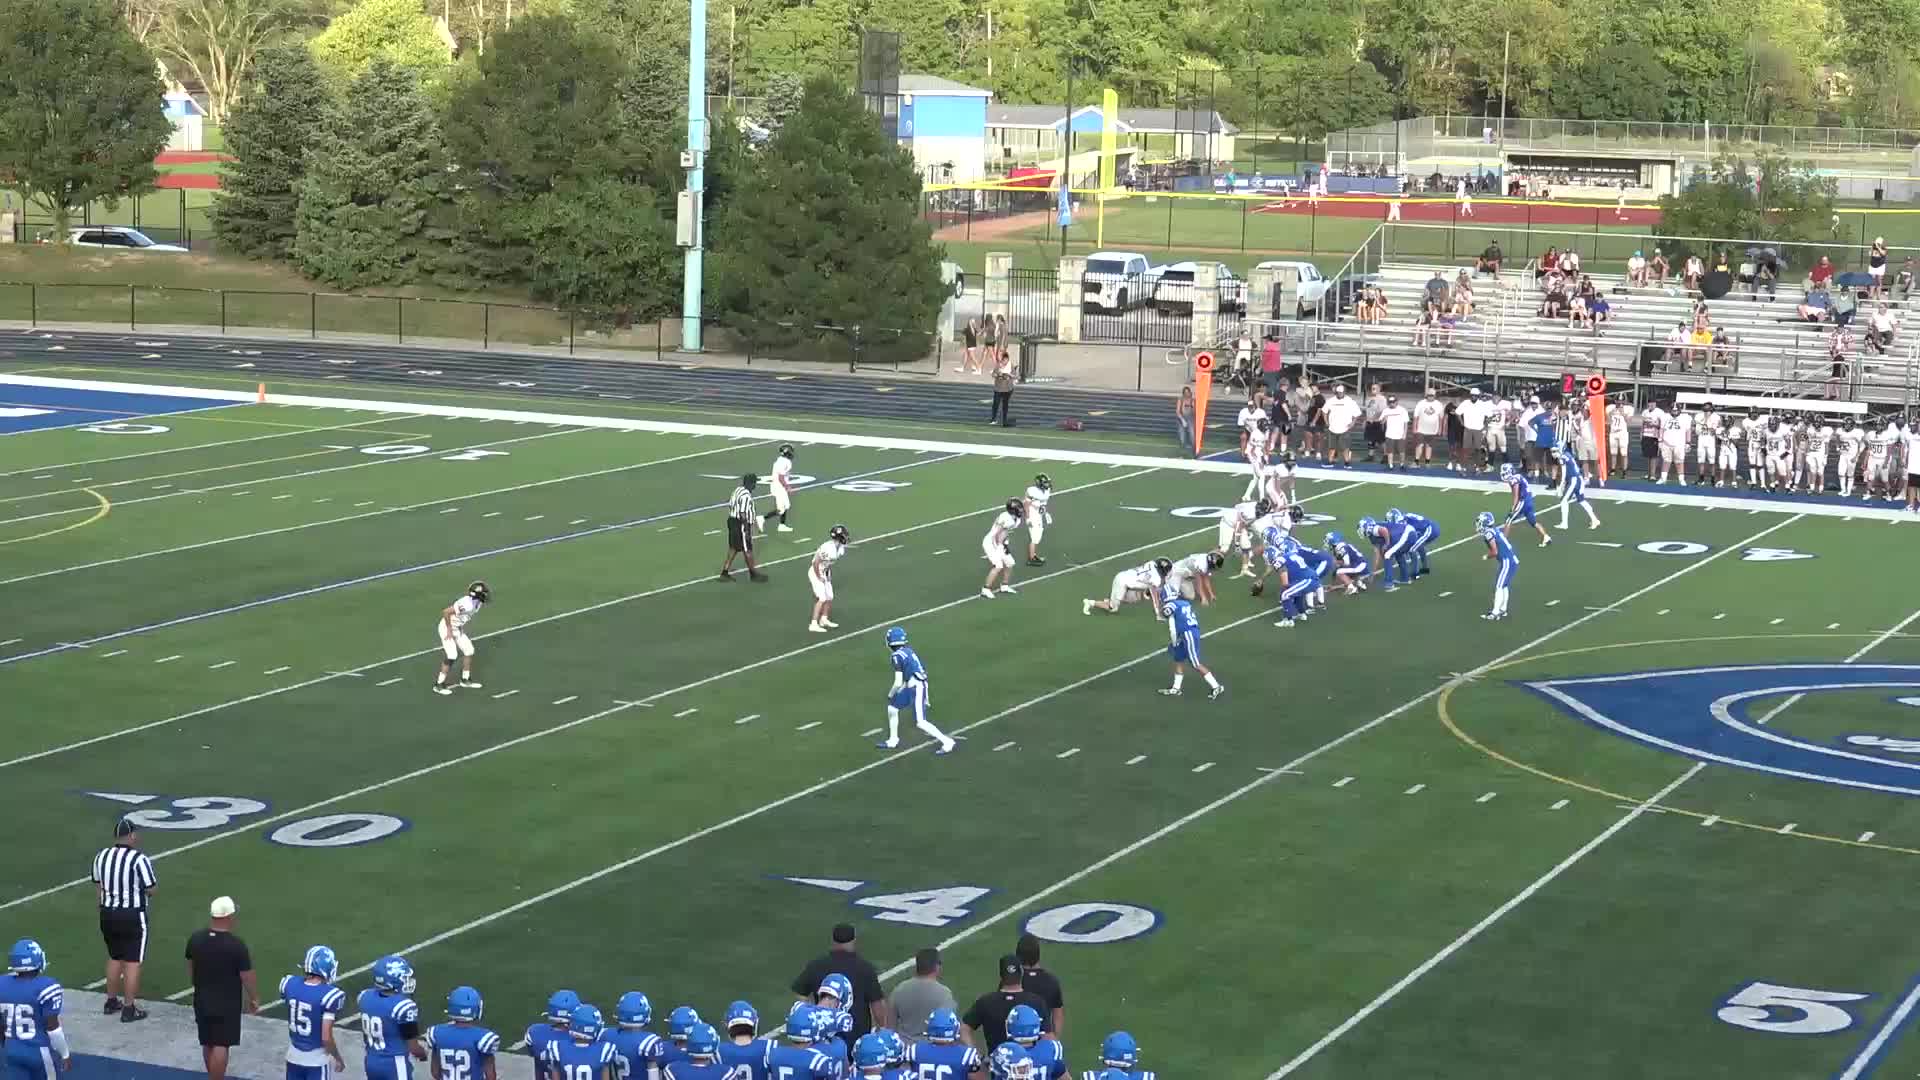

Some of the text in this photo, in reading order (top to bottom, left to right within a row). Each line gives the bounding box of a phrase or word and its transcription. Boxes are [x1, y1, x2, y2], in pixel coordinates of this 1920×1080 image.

[1668, 421, 1680, 430] 75
[0, 1003, 37, 1040] 76
[288, 999, 312, 1037] 15
[440, 1049, 471, 1080] 52
